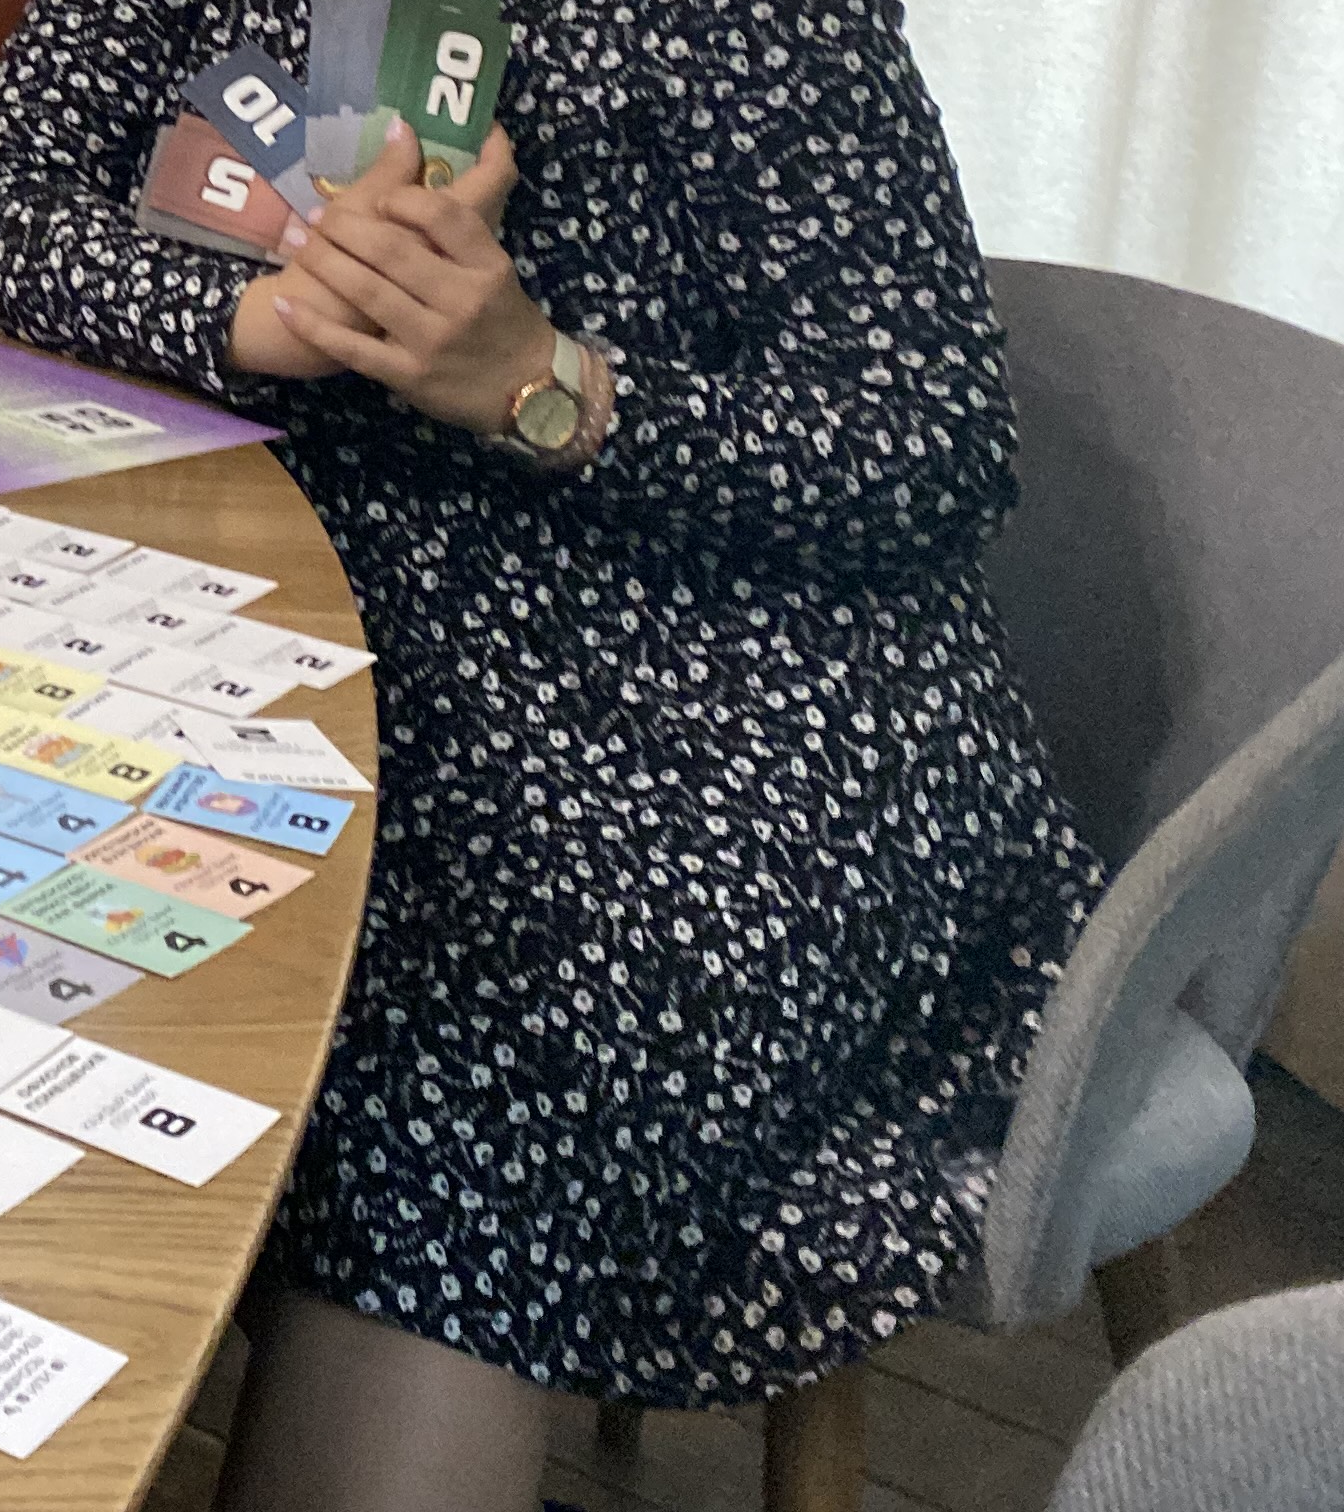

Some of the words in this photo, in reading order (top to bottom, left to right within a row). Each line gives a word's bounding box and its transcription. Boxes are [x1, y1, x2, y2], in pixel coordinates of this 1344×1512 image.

[425, 30, 484, 127] 20
[222, 73, 298, 148] 10
[200, 156, 256, 213] 5
[146, 612, 187, 629] 2
[64, 638, 106, 655] 2
[294, 654, 335, 671] 2
[33, 683, 76, 702] 8
[211, 680, 253, 698] 2
[108, 761, 151, 783] 8
[57, 811, 99, 834] 4
[287, 812, 332, 834] 8
[228, 876, 270, 898] 4
[162, 928, 209, 954] 4
[47, 977, 97, 1003] 4
[138, 1107, 197, 1139] 8
